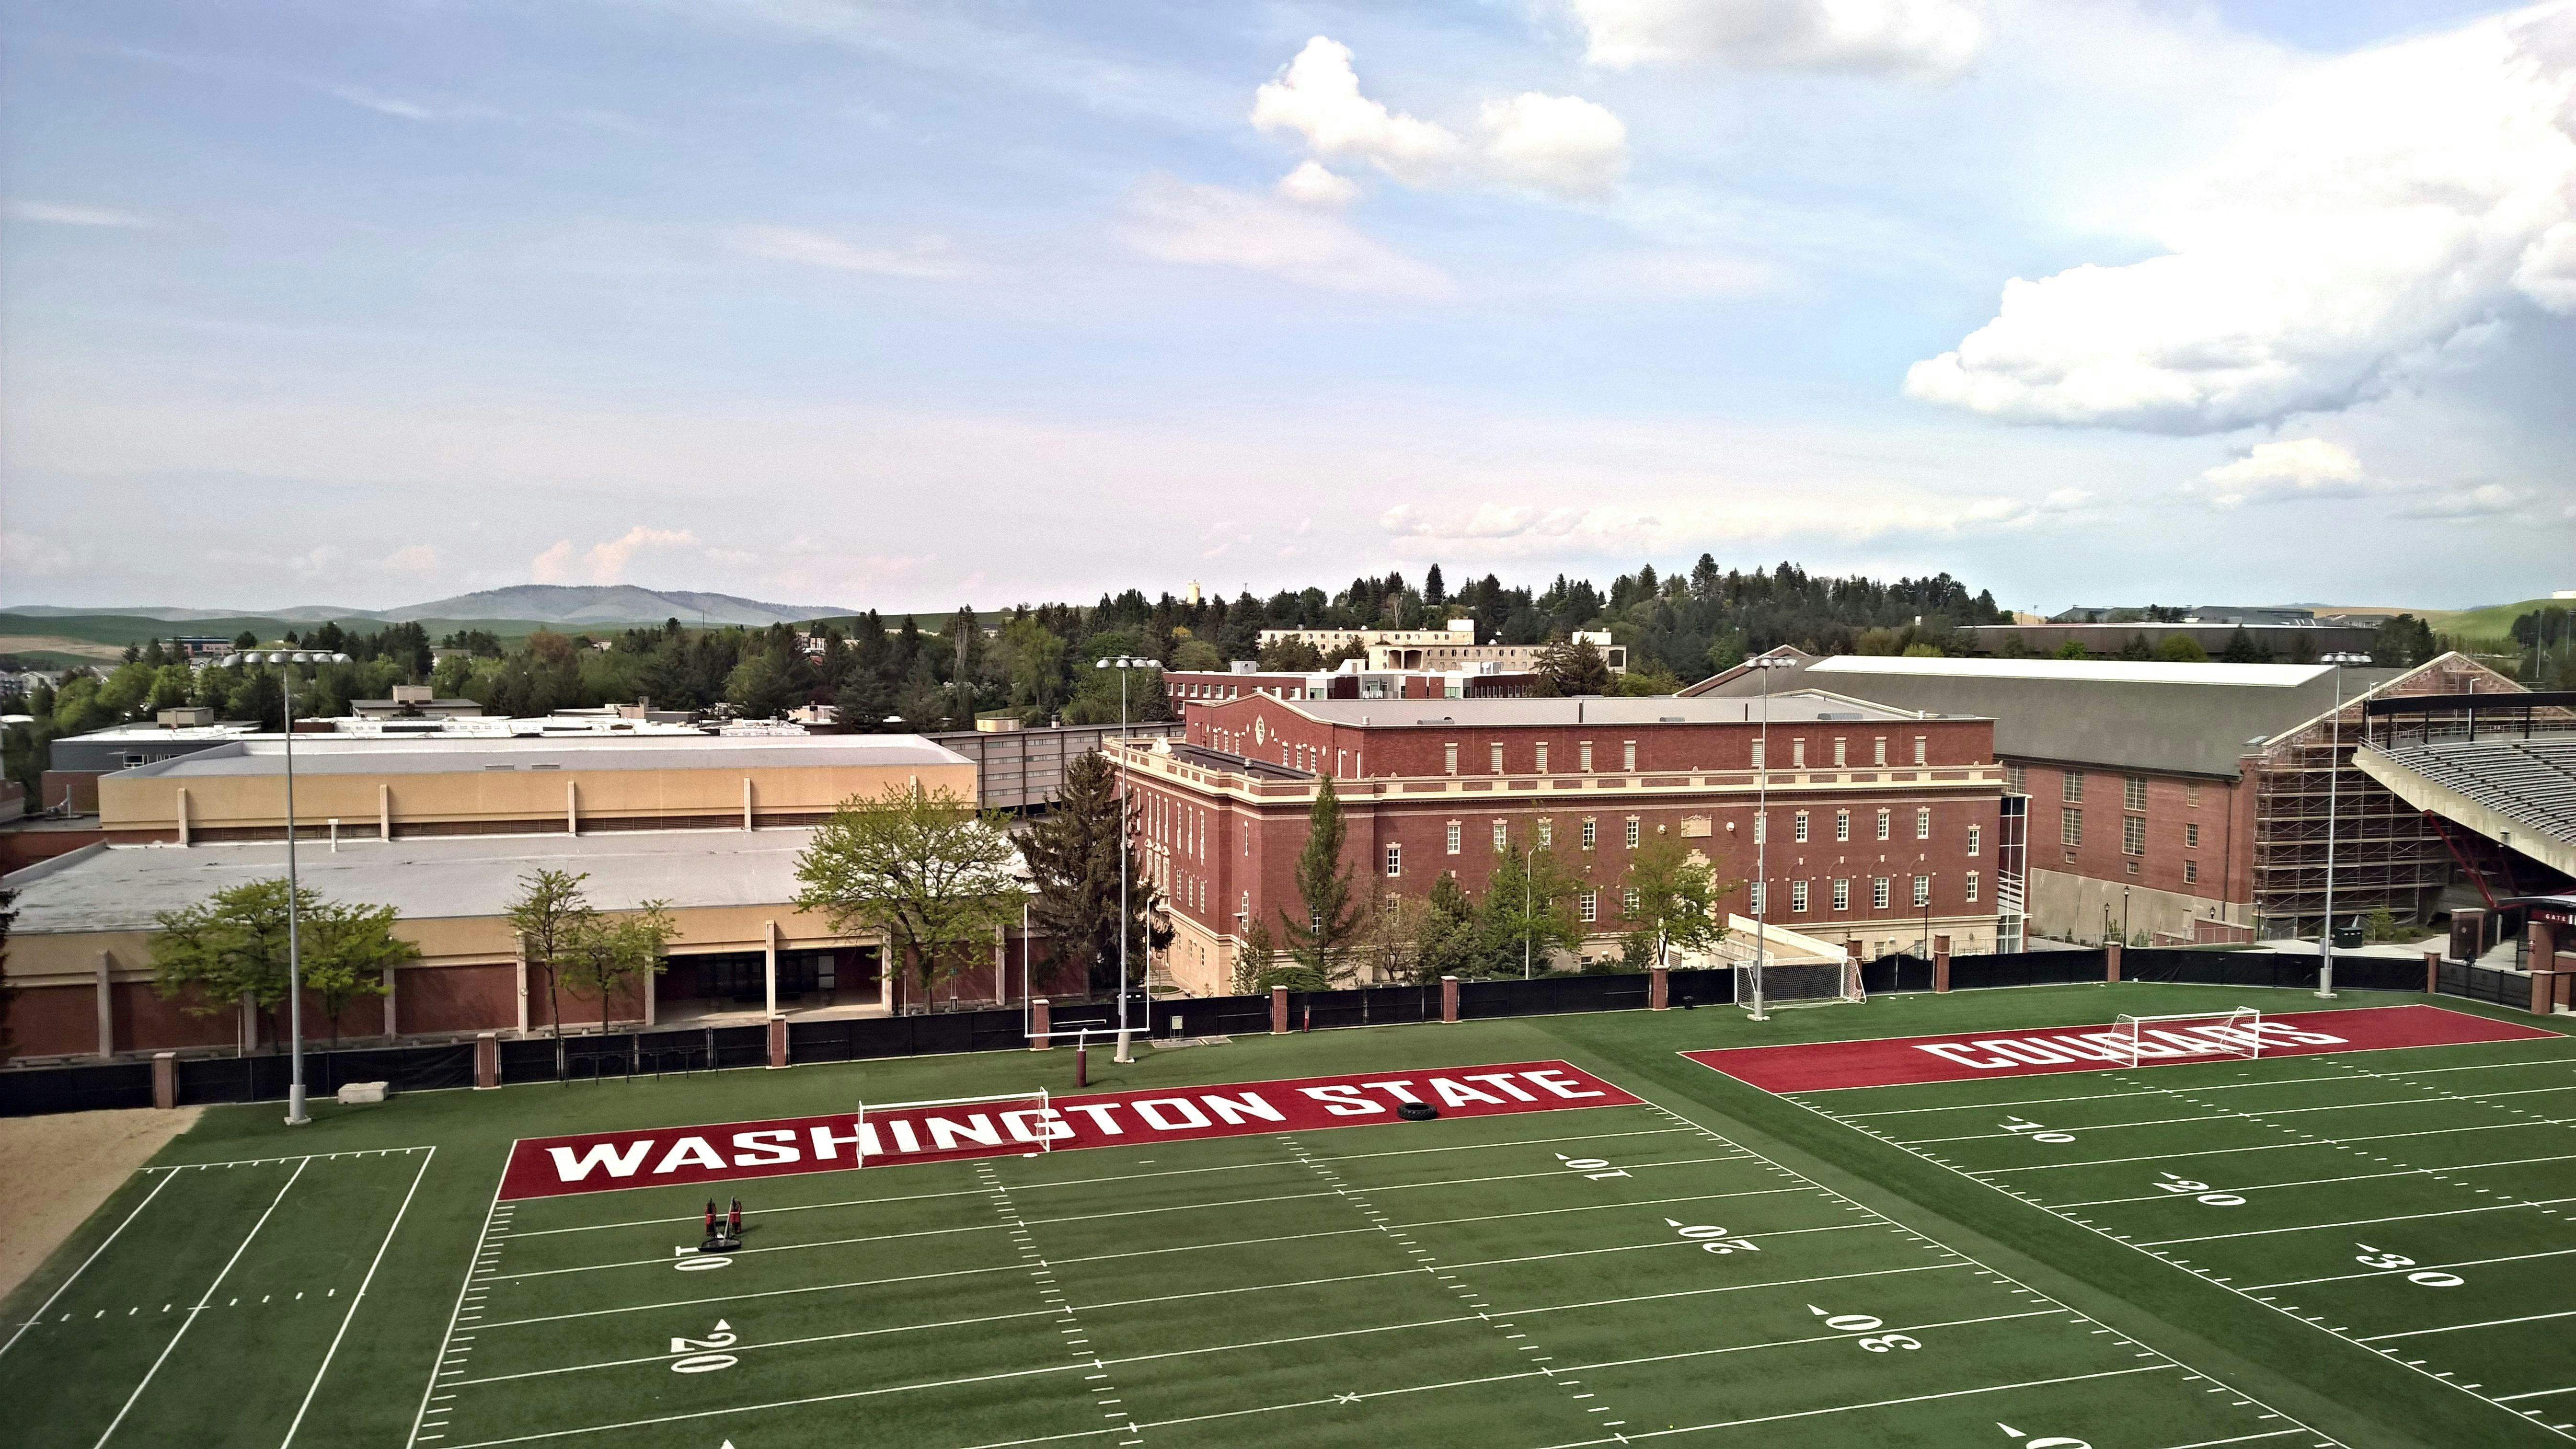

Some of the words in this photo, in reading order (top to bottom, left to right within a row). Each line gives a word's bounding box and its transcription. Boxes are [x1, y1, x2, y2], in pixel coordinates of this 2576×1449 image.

[1911, 1023, 2349, 1069] COUGARS
[544, 1092, 1287, 1182] WASHINGTON
[1296, 1070, 1607, 1116] STATE
[1998, 1121, 2076, 1143] 10
[1564, 1158, 1633, 1181] 10
[2153, 1179, 2246, 1206] 20
[1678, 1225, 1761, 1254] 20
[2356, 1254, 2465, 1287] 30
[1825, 1314, 1922, 1353] 30
[671, 1332, 738, 1373] 20
